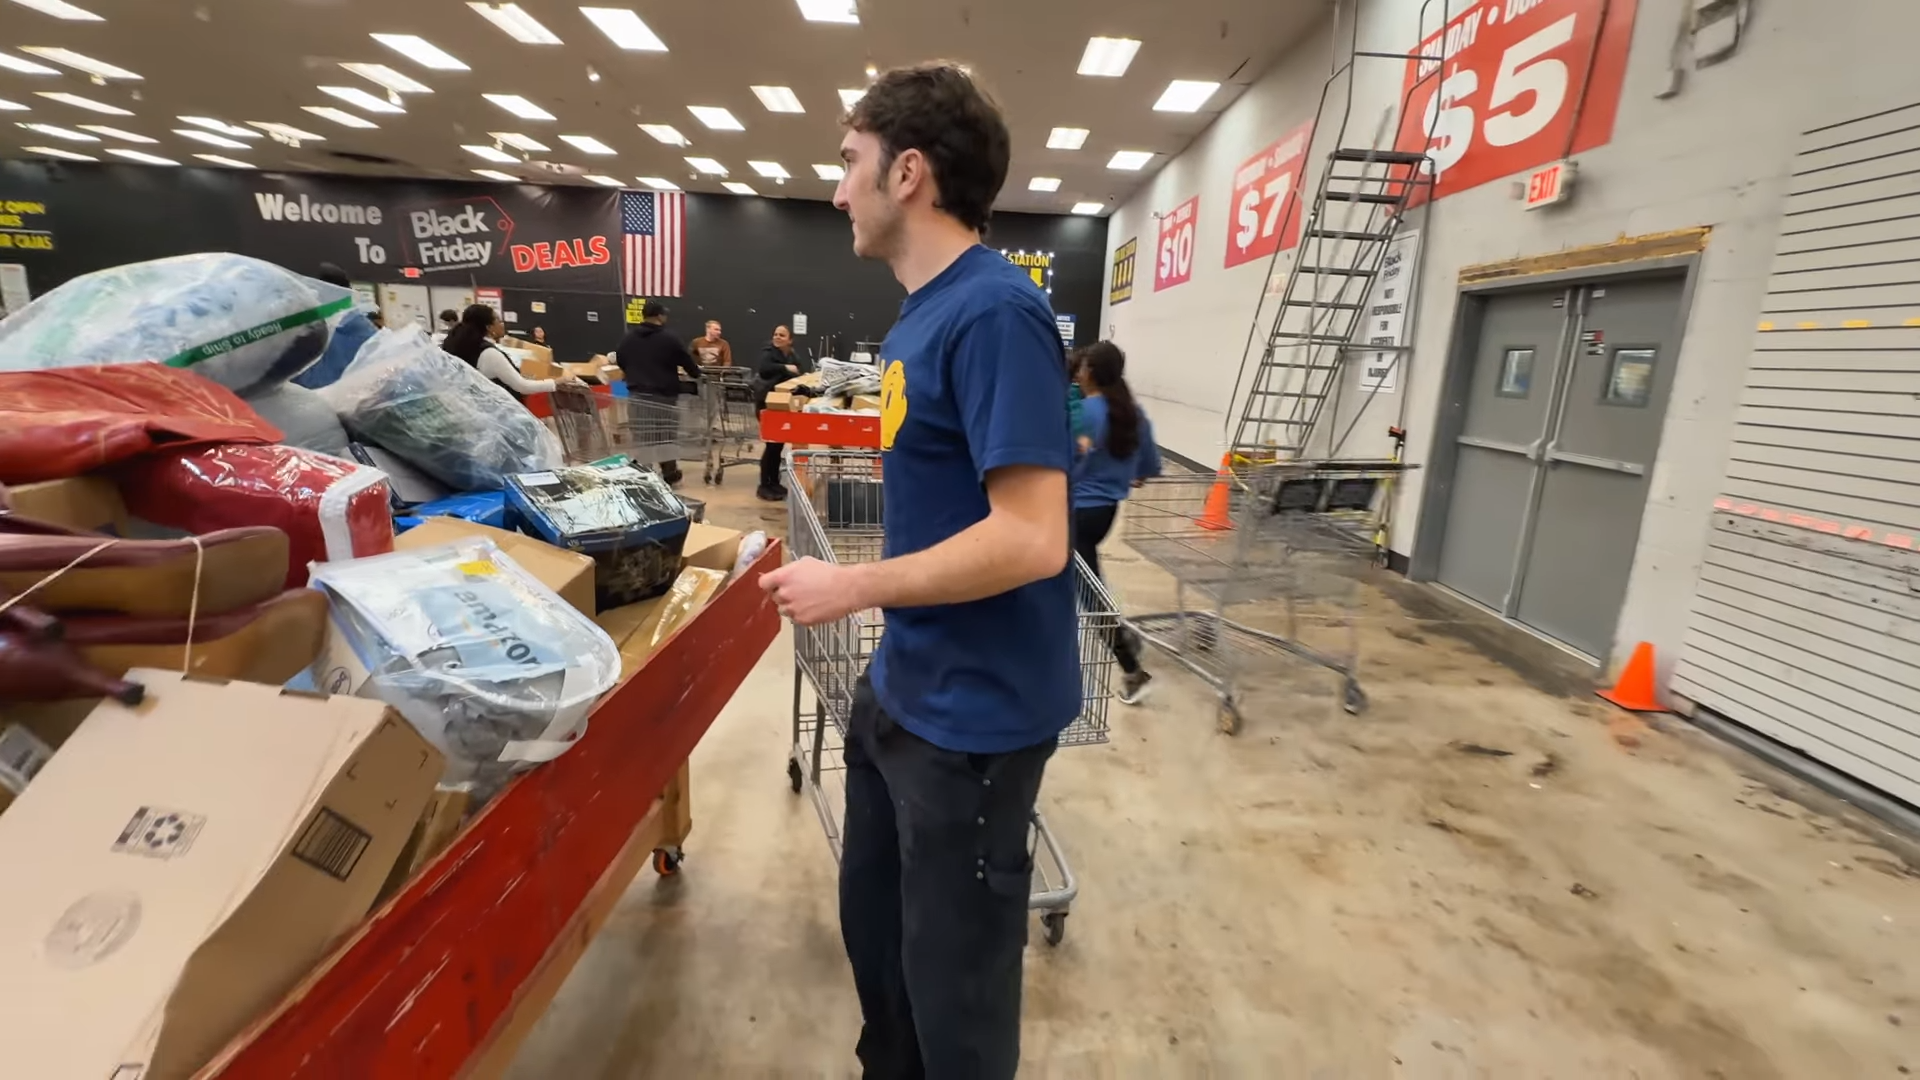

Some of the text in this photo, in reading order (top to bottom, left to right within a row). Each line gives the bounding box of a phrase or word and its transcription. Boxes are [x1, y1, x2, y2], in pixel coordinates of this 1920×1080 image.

[1419, 12, 1577, 184] $5
[1528, 166, 1560, 204] EXIT
[254, 193, 382, 225] Welcome
[410, 205, 490, 238] Black
[1236, 171, 1292, 254] $7
[354, 237, 386, 264] To
[418, 238, 491, 265] Friday
[510, 236, 610, 273] DEALS
[1007, 253, 1050, 267] STATION
[1160, 222, 1192, 283] $10
[1384, 251, 1402, 268] Black
[202, 322, 283, 356] Ready to Ship
